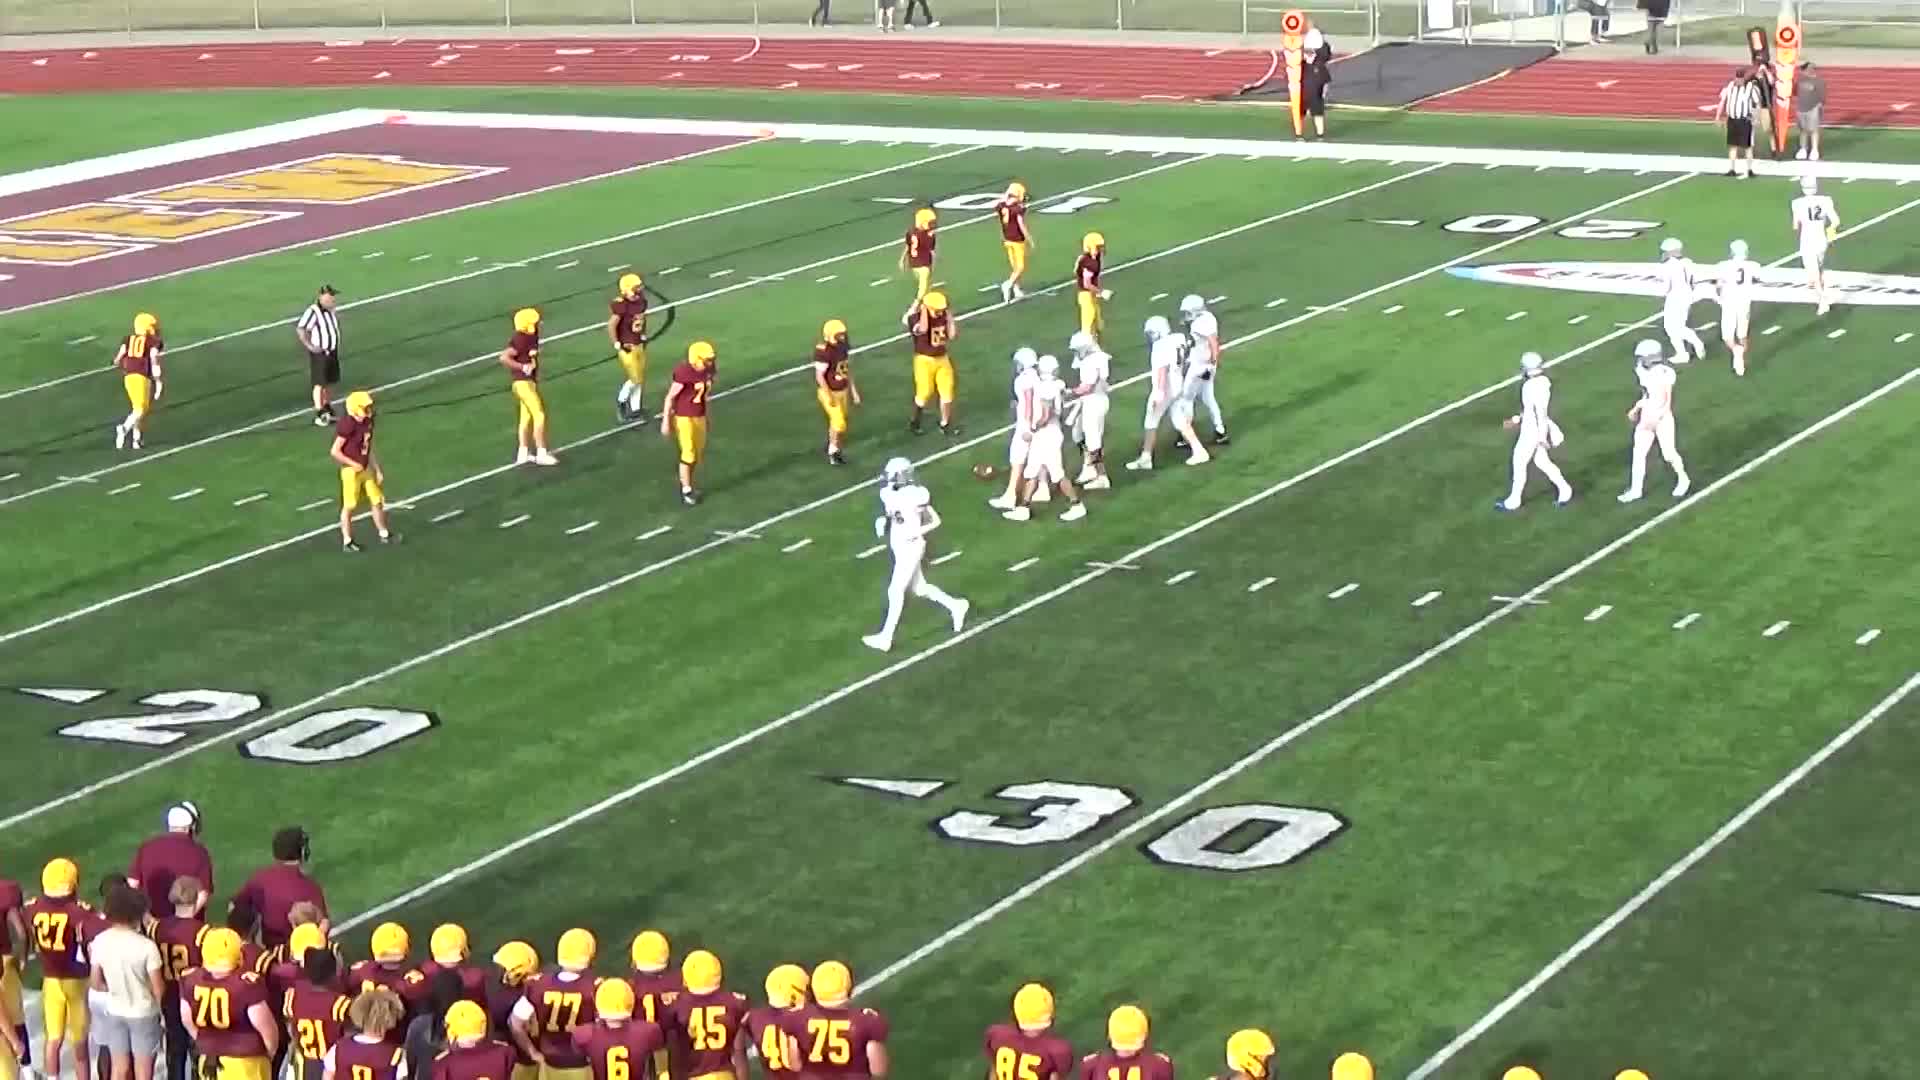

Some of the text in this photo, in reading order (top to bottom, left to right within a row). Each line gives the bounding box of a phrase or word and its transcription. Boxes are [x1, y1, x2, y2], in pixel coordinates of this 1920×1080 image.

[0, 153, 510, 281] IEW
[1443, 213, 1663, 239] 20
[1808, 206, 1823, 221] 12
[128, 335, 146, 358] 10
[56, 689, 437, 763] 20
[937, 780, 1346, 871] 30
[33, 911, 69, 952] 27
[193, 985, 231, 1029] 70
[543, 991, 583, 1032] 77
[296, 1018, 327, 1060] 21
[688, 1005, 728, 1051] 45
[807, 1017, 851, 1065] 75
[606, 1045, 630, 1080] 6
[995, 1046, 1042, 1080] 85
